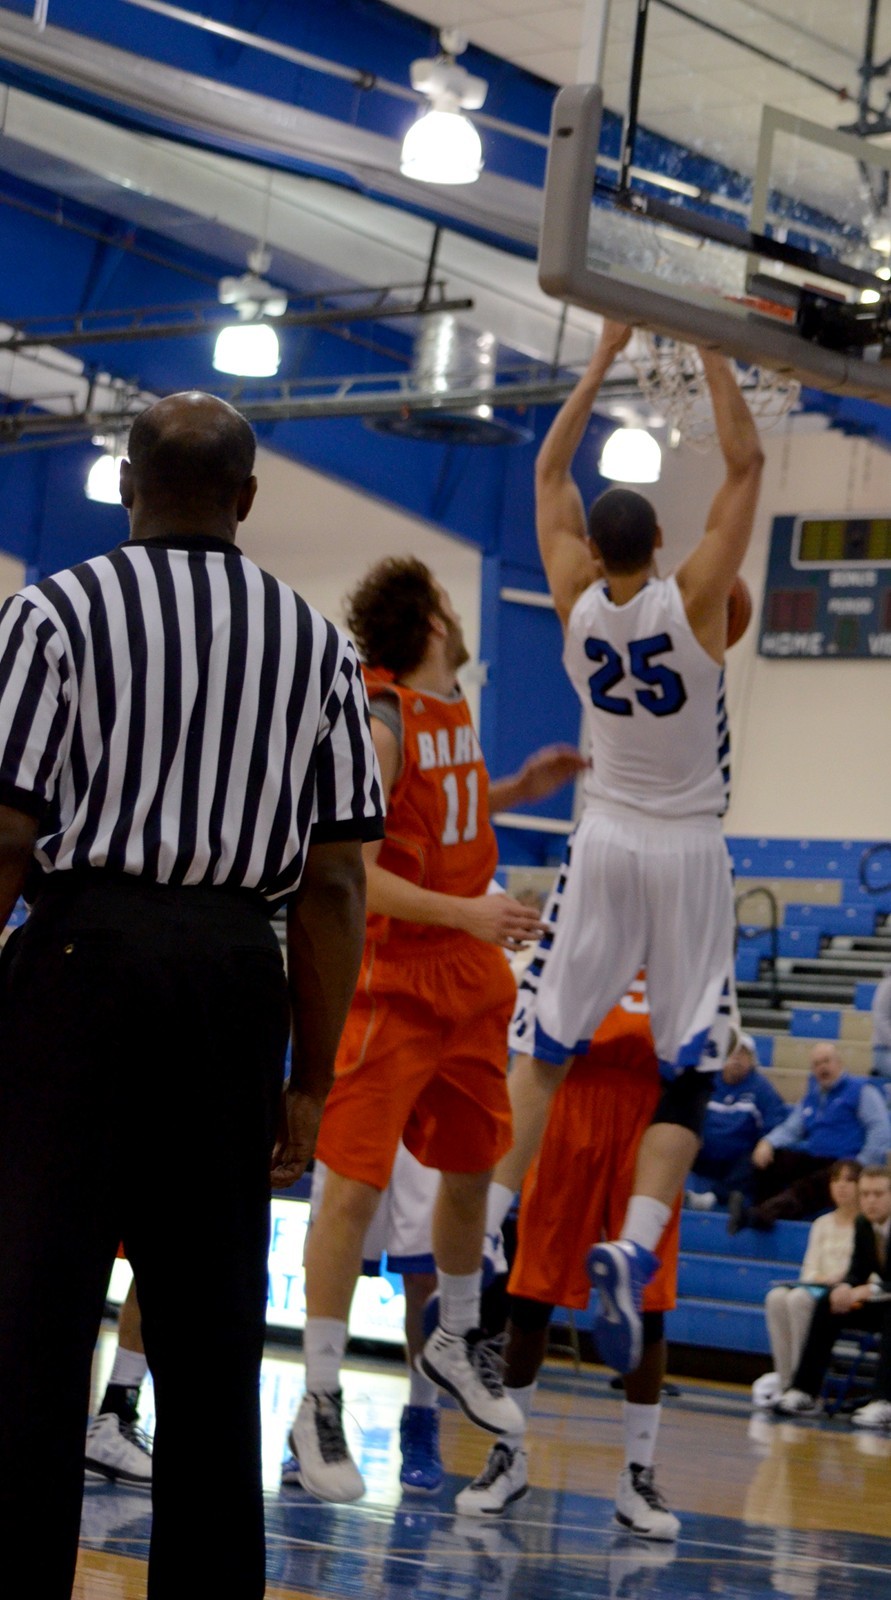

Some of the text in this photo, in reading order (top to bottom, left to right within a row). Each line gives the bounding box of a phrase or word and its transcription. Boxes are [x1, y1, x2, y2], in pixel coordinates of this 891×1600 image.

[584, 633, 688, 717] 25
[761, 632, 824, 656] HOME
[441, 769, 478, 845] 11
